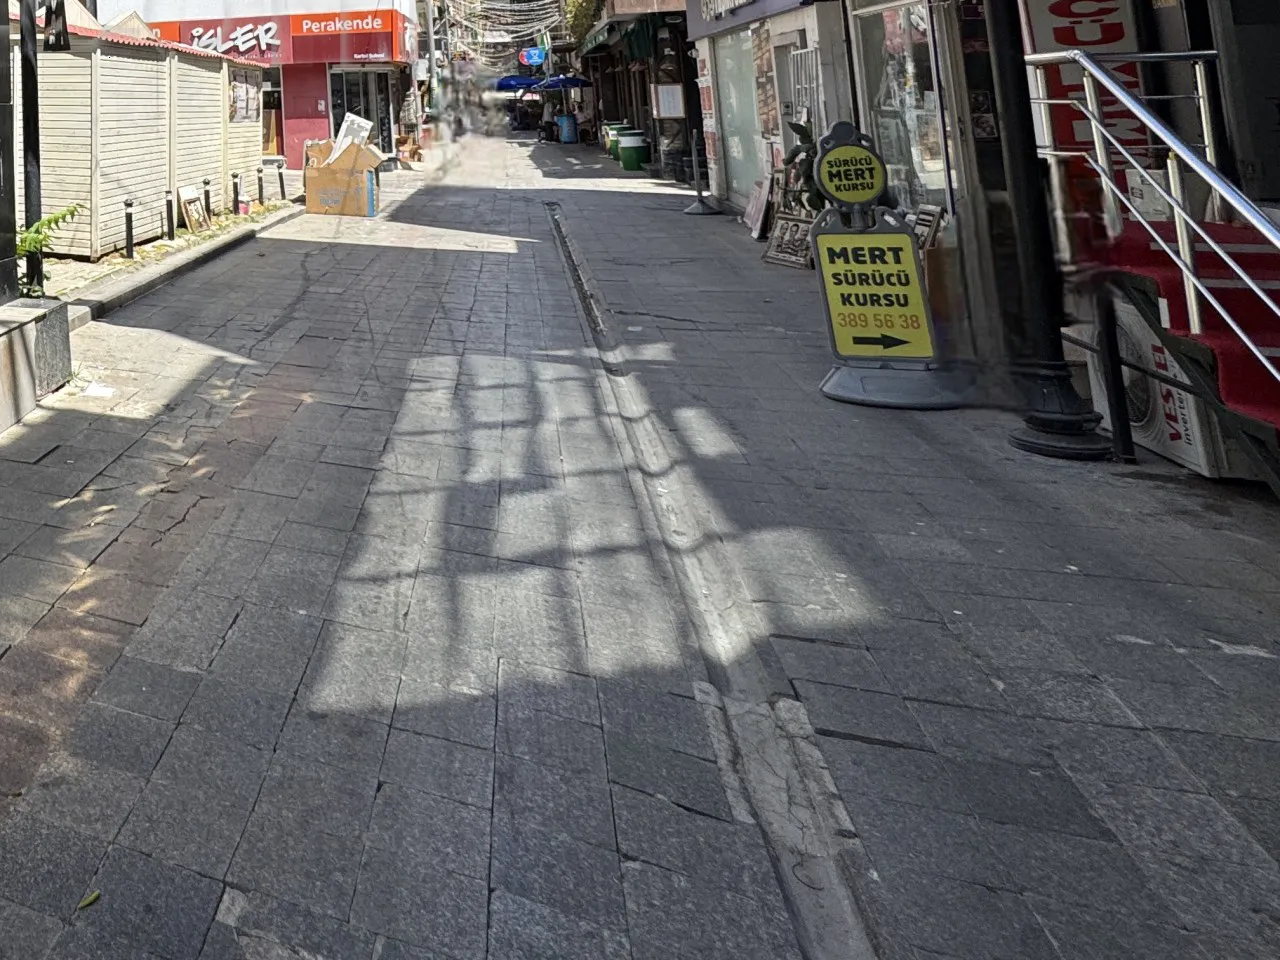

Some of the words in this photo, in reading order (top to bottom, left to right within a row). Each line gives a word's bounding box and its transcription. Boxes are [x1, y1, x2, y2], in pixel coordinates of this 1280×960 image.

[302, 15, 382, 33] Perakende
[826, 156, 873, 169] SÜRÜCÜ
[827, 167, 876, 182] MERT
[834, 180, 874, 193] KURSU
[826, 246, 904, 265] MERT
[831, 271, 910, 287] SÜRÜCÜ
[840, 292, 909, 308] KURSU
[837, 312, 868, 328] 389
[873, 313, 894, 329] 56
[899, 314, 921, 329] 38
